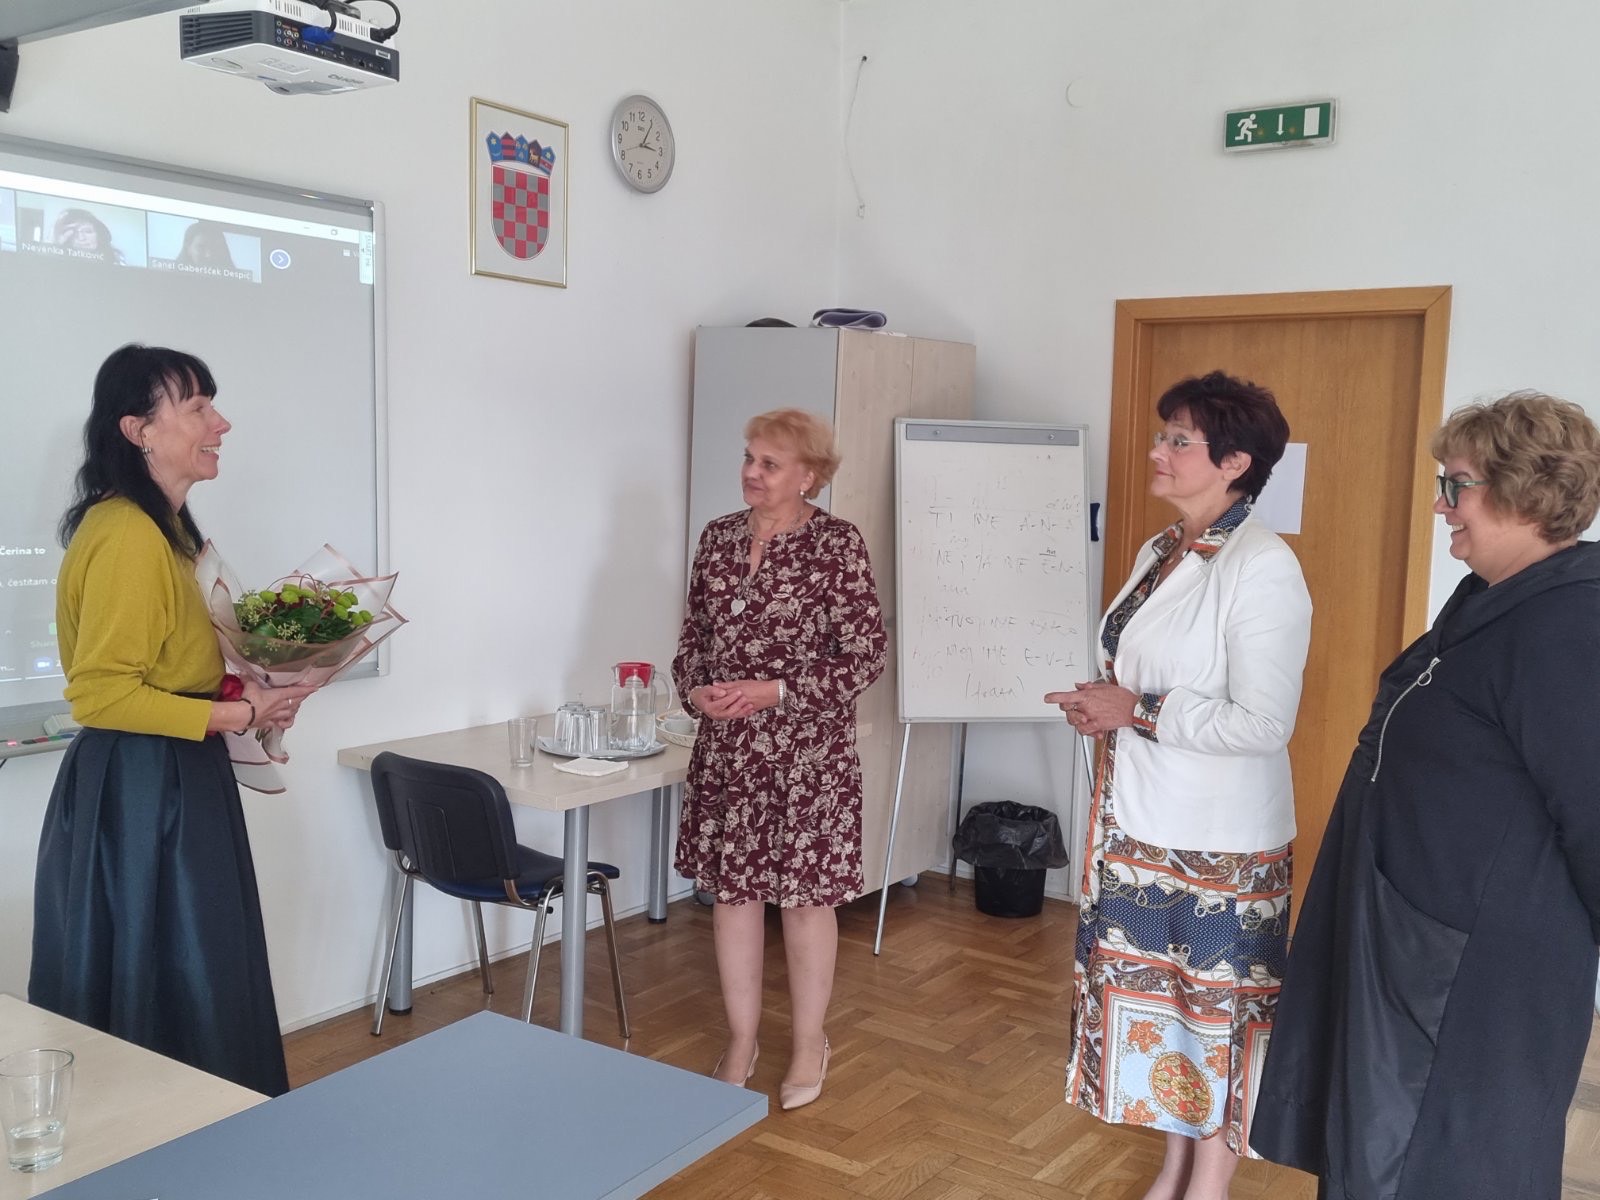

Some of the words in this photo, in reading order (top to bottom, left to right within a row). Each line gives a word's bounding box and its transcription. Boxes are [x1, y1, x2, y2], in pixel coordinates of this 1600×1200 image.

[629, 112, 636, 122] 11
[638, 111, 646, 122] 12
[621, 120, 629, 132] 10
[617, 133, 623, 144] 9
[655, 131, 661, 142] 2
[620, 149, 626, 161] 8
[658, 146, 663, 157] 3
[628, 162, 634, 173] 7
[654, 160, 659, 171] 4
[637, 169, 642, 180] 6
[647, 168, 652, 179] 5
[34, 547, 47, 555] to
